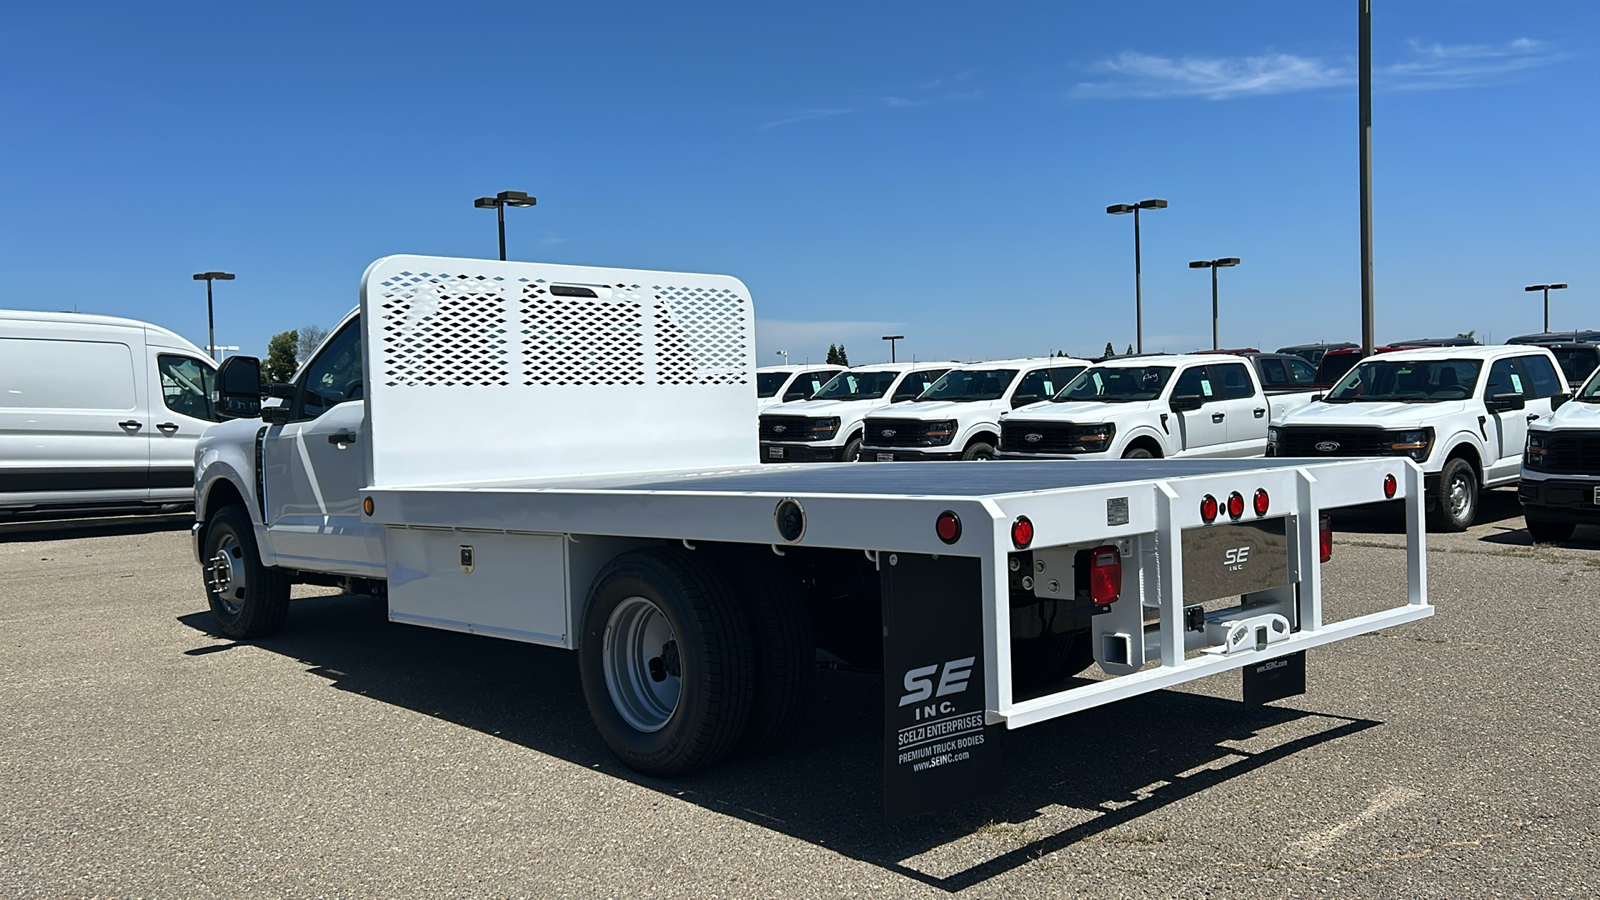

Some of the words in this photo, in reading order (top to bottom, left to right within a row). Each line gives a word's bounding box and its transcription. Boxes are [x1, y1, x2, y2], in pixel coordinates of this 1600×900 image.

[1223, 546, 1250, 565] SE
[898, 656, 976, 707] SE
[915, 701, 956, 720] INC.
[898, 728, 925, 745] SCELZI
[928, 714, 983, 738] ENTERPRISES
[898, 746, 932, 764] PREMIUM
[932, 740, 957, 755] TRUCK
[957, 734, 984, 749] BODIES
[913, 751, 970, 772] www.SEINC.com
